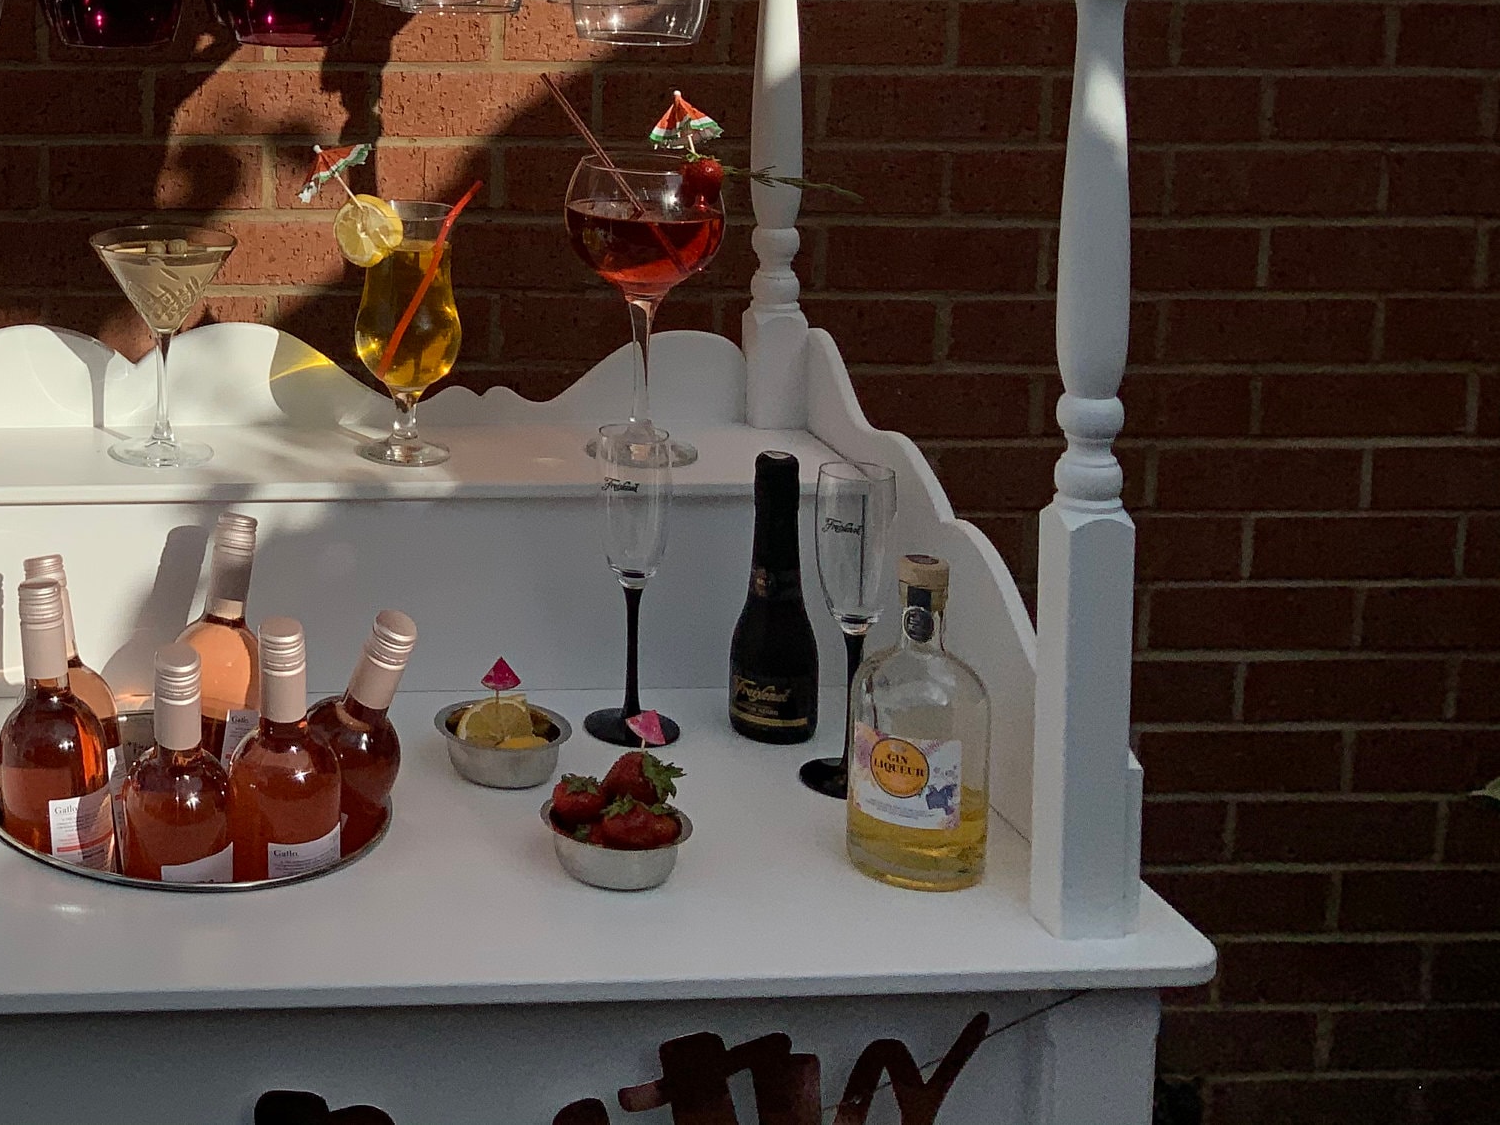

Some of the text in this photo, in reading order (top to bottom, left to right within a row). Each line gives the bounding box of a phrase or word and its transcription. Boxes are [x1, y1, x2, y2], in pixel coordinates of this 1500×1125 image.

[887, 754, 909, 765] GIN
[874, 757, 925, 778] LIQUEUR
[54, 804, 77, 815] Gallo
